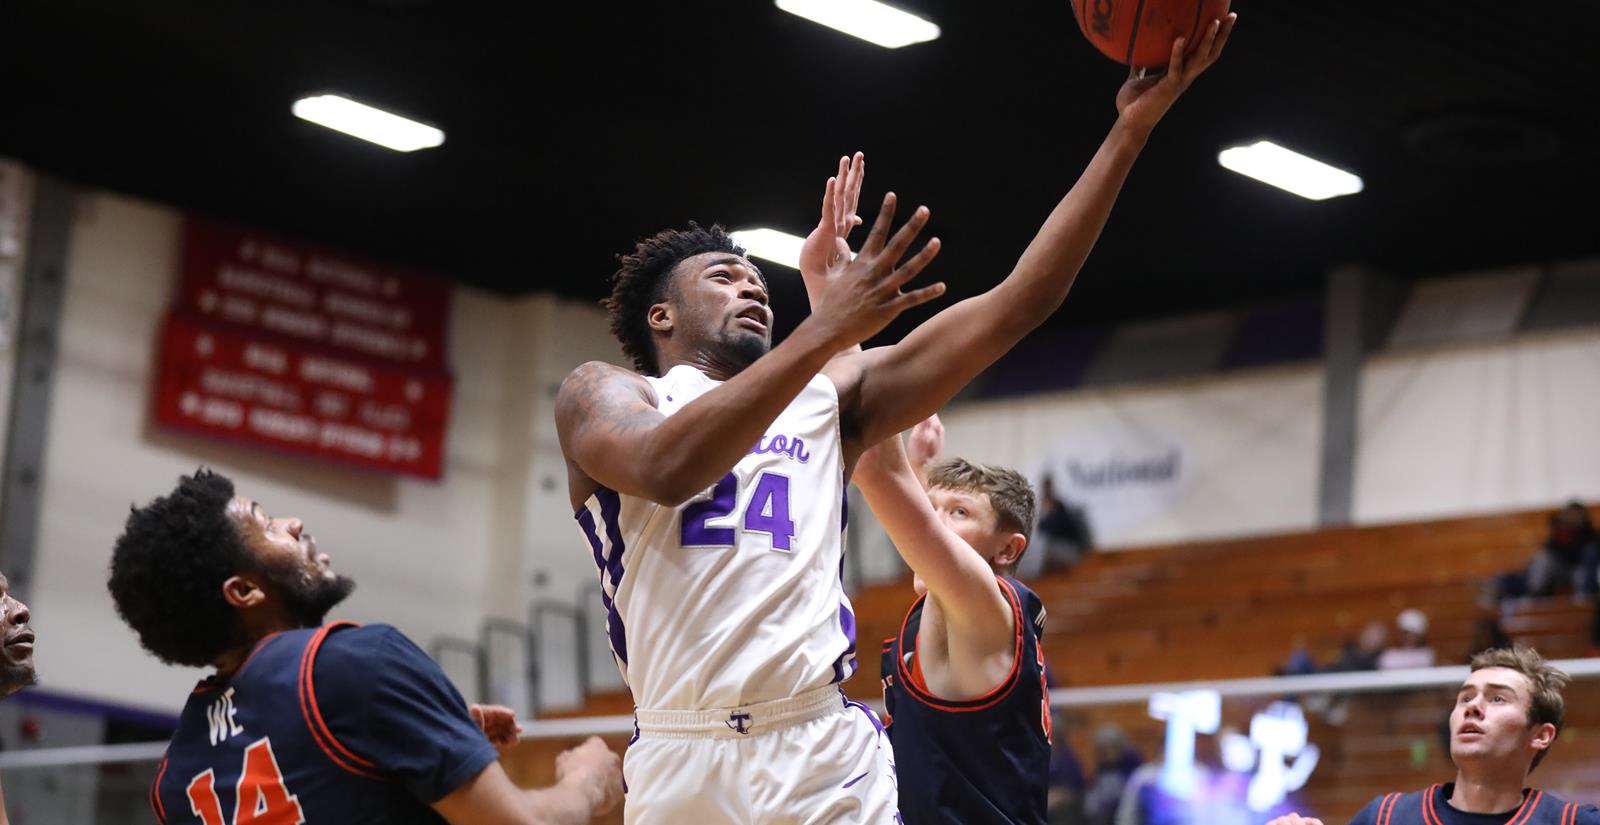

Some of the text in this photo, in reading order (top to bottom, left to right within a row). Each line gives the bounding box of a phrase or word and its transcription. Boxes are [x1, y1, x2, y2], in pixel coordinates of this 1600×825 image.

[750, 433, 810, 465] ton
[679, 469, 797, 553] 24
[207, 686, 245, 747] WE
[186, 736, 306, 825] 14
